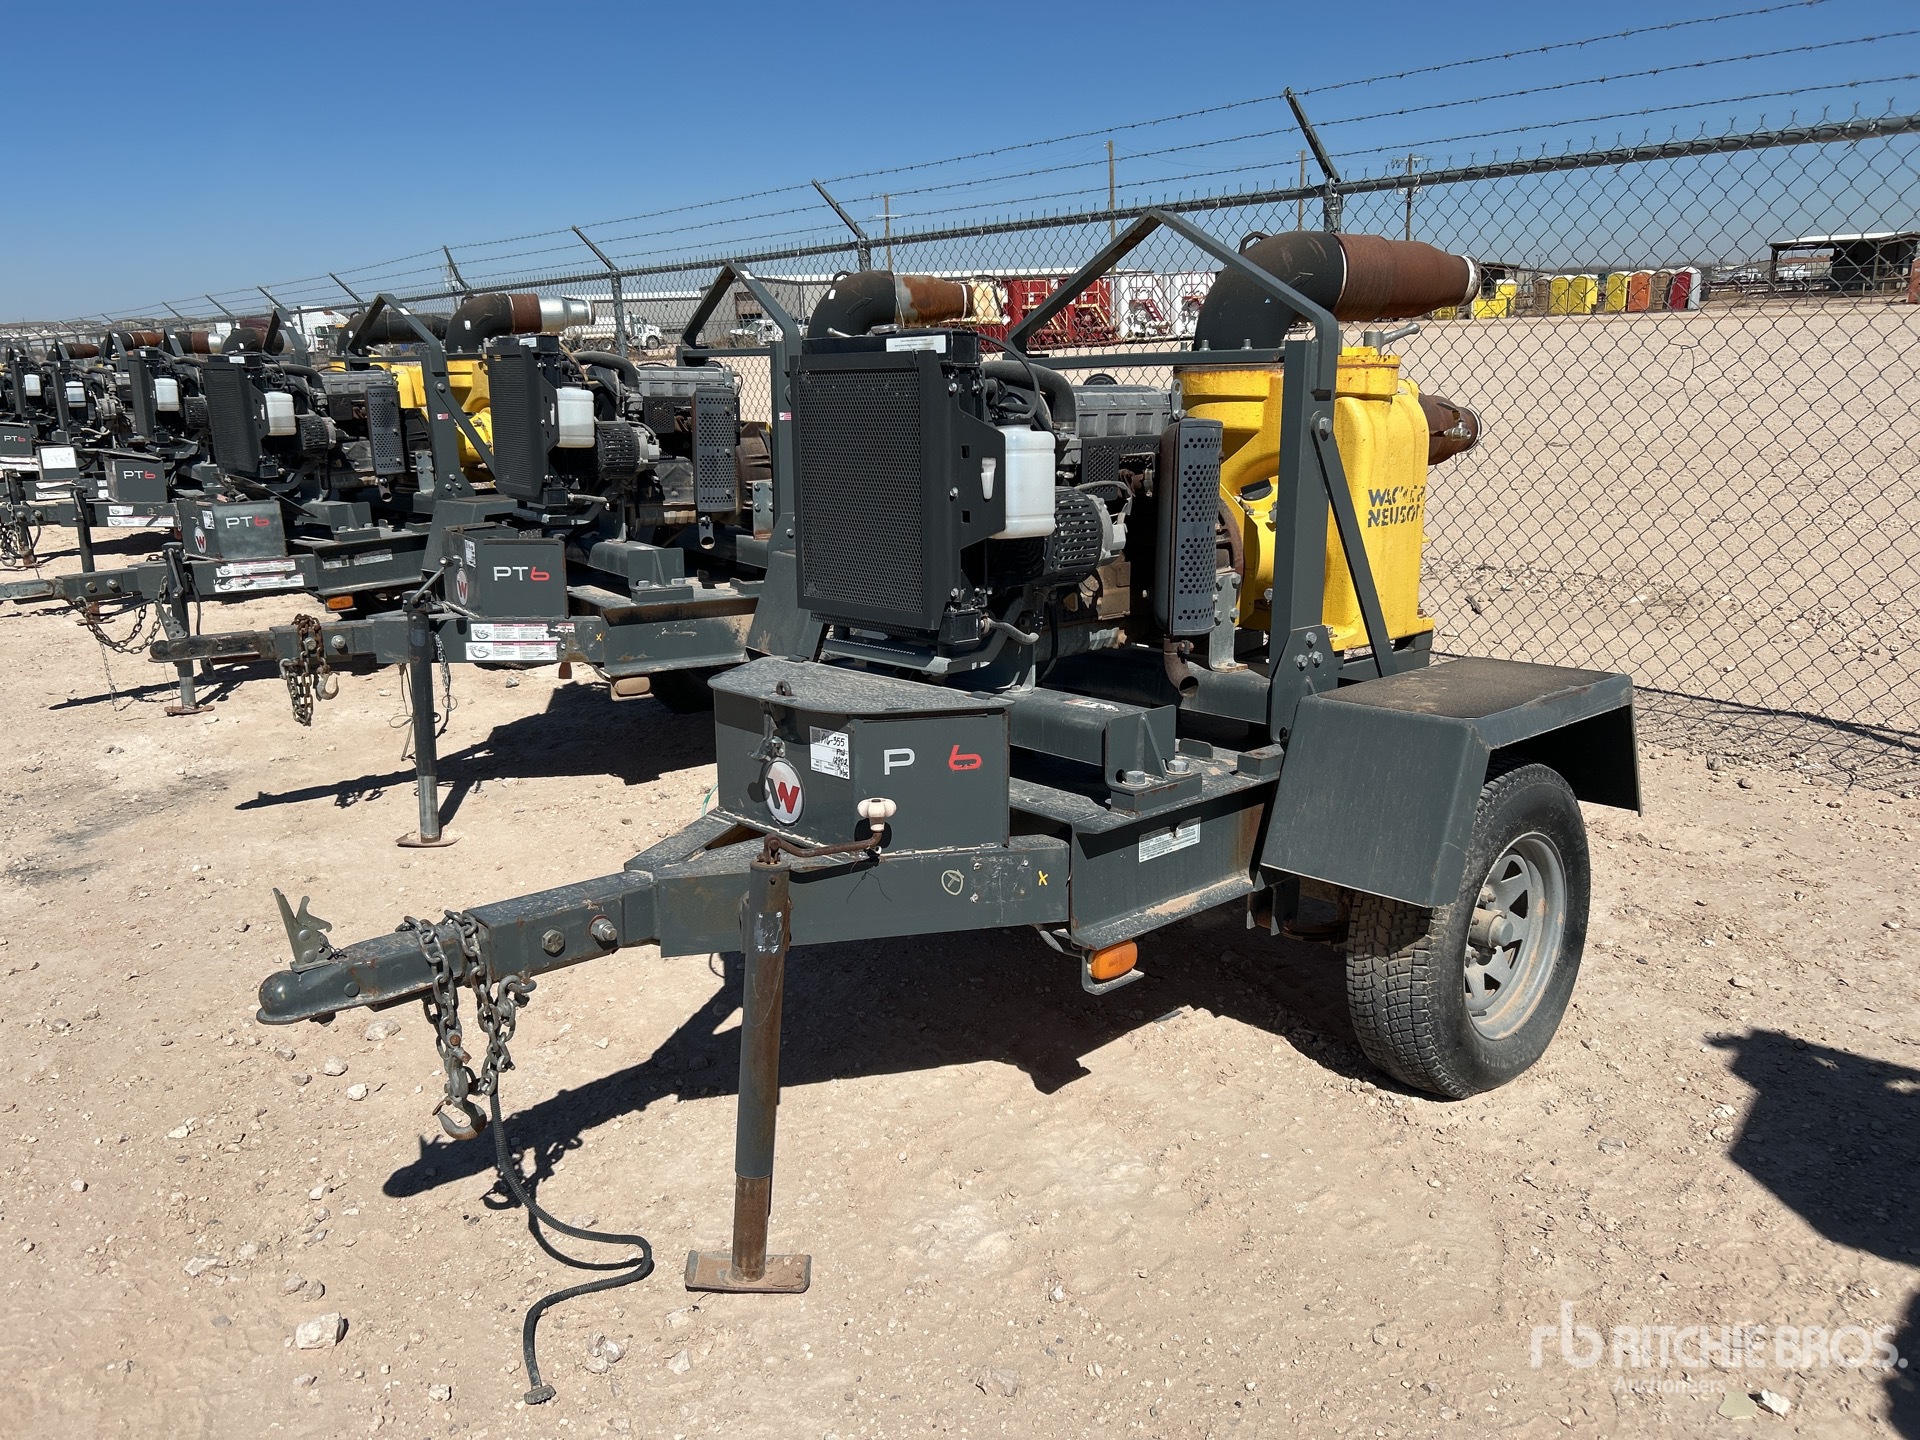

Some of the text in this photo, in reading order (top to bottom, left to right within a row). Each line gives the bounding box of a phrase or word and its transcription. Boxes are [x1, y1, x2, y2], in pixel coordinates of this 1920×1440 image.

[1368, 485, 1425, 507] WAC
[225, 516, 270, 529] PT6
[493, 566, 550, 582] PT6
